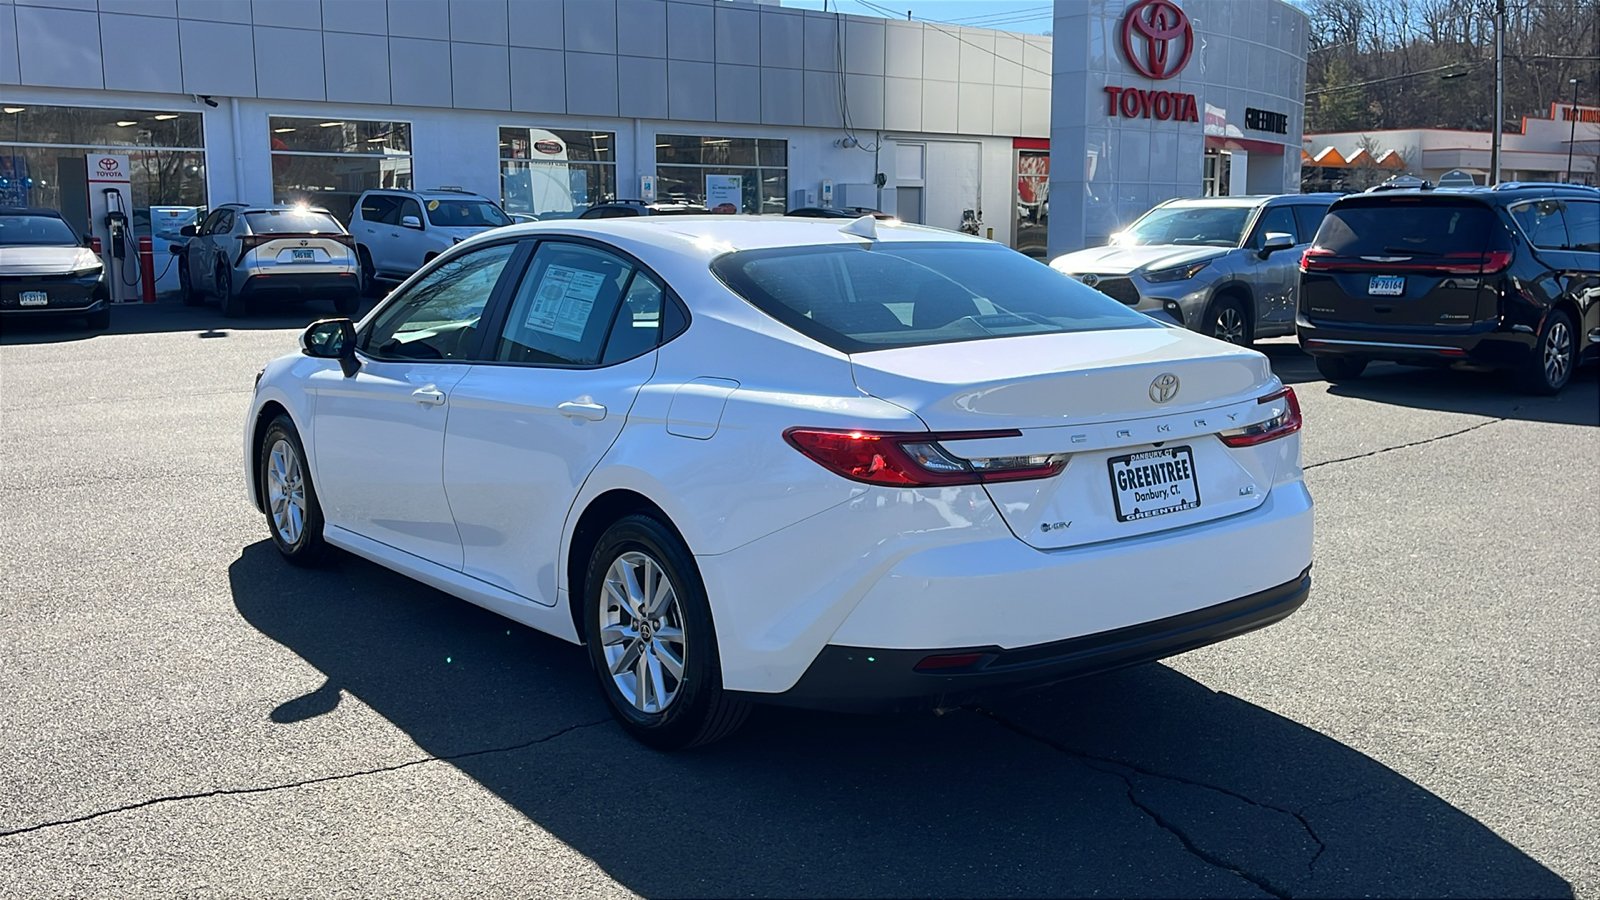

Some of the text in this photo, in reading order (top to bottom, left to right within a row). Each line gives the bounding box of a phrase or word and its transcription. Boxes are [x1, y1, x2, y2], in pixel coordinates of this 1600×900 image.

[1104, 86, 1199, 123] TOYOTA
[1071, 412, 1238, 443] CAMRY
[1117, 458, 1190, 492] GREENTREE
[1134, 487, 1170, 503] Danbury,
[1125, 501, 1198, 522] GREENTREE
